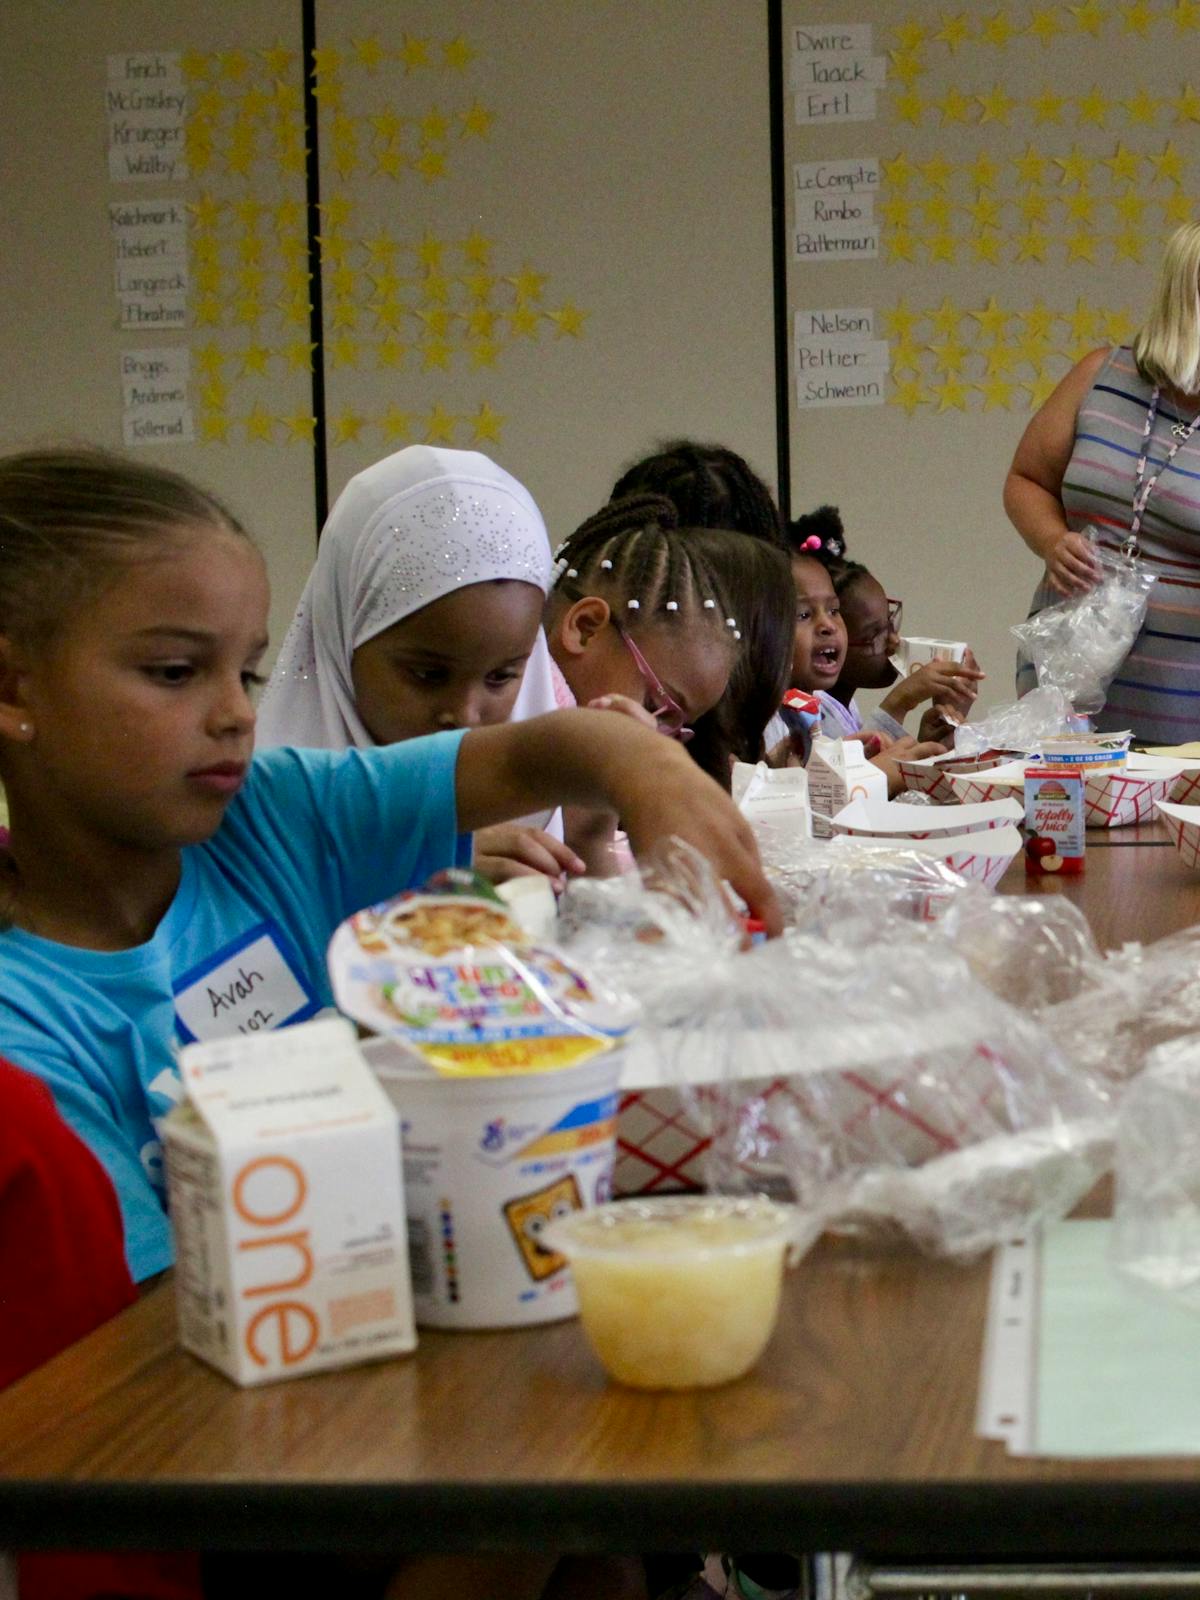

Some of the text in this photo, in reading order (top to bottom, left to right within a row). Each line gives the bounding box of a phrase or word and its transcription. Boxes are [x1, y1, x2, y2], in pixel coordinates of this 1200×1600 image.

[796, 30, 854, 51] Dwire
[806, 61, 868, 82] Taack
[807, 92, 850, 117] Ertl
[113, 120, 181, 149] Krueger
[814, 199, 862, 222] Rimbo
[796, 233, 876, 254] Batterman
[811, 313, 871, 334] Nelson
[798, 347, 867, 370] Peltier
[804, 381, 880, 401] Schwenn
[1035, 808, 1074, 823] Totally
[1035, 820, 1068, 832] Juice
[206, 967, 265, 1018] Avah
[232, 1154, 320, 1367] one
